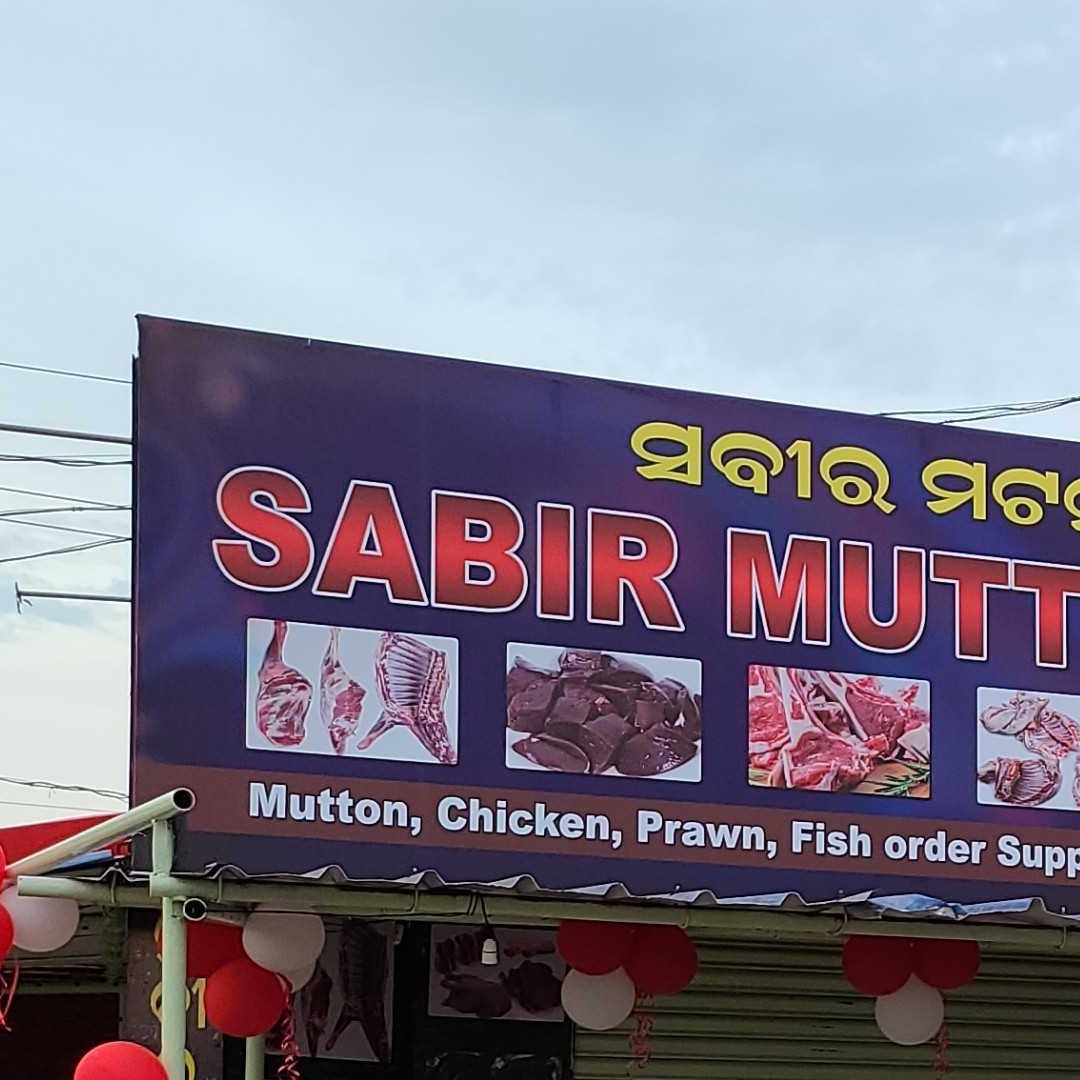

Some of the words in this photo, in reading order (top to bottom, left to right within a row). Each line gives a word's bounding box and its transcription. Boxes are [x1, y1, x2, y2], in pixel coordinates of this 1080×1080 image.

[630, 421, 897, 515] ସବୀର
[211, 465, 686, 633] SABIR
[249, 782, 422, 836] Mutton,
[437, 796, 623, 849] Chicken,
[637, 810, 778, 859] Prawn,
[791, 820, 872, 857] Fish
[883, 831, 987, 864] order
